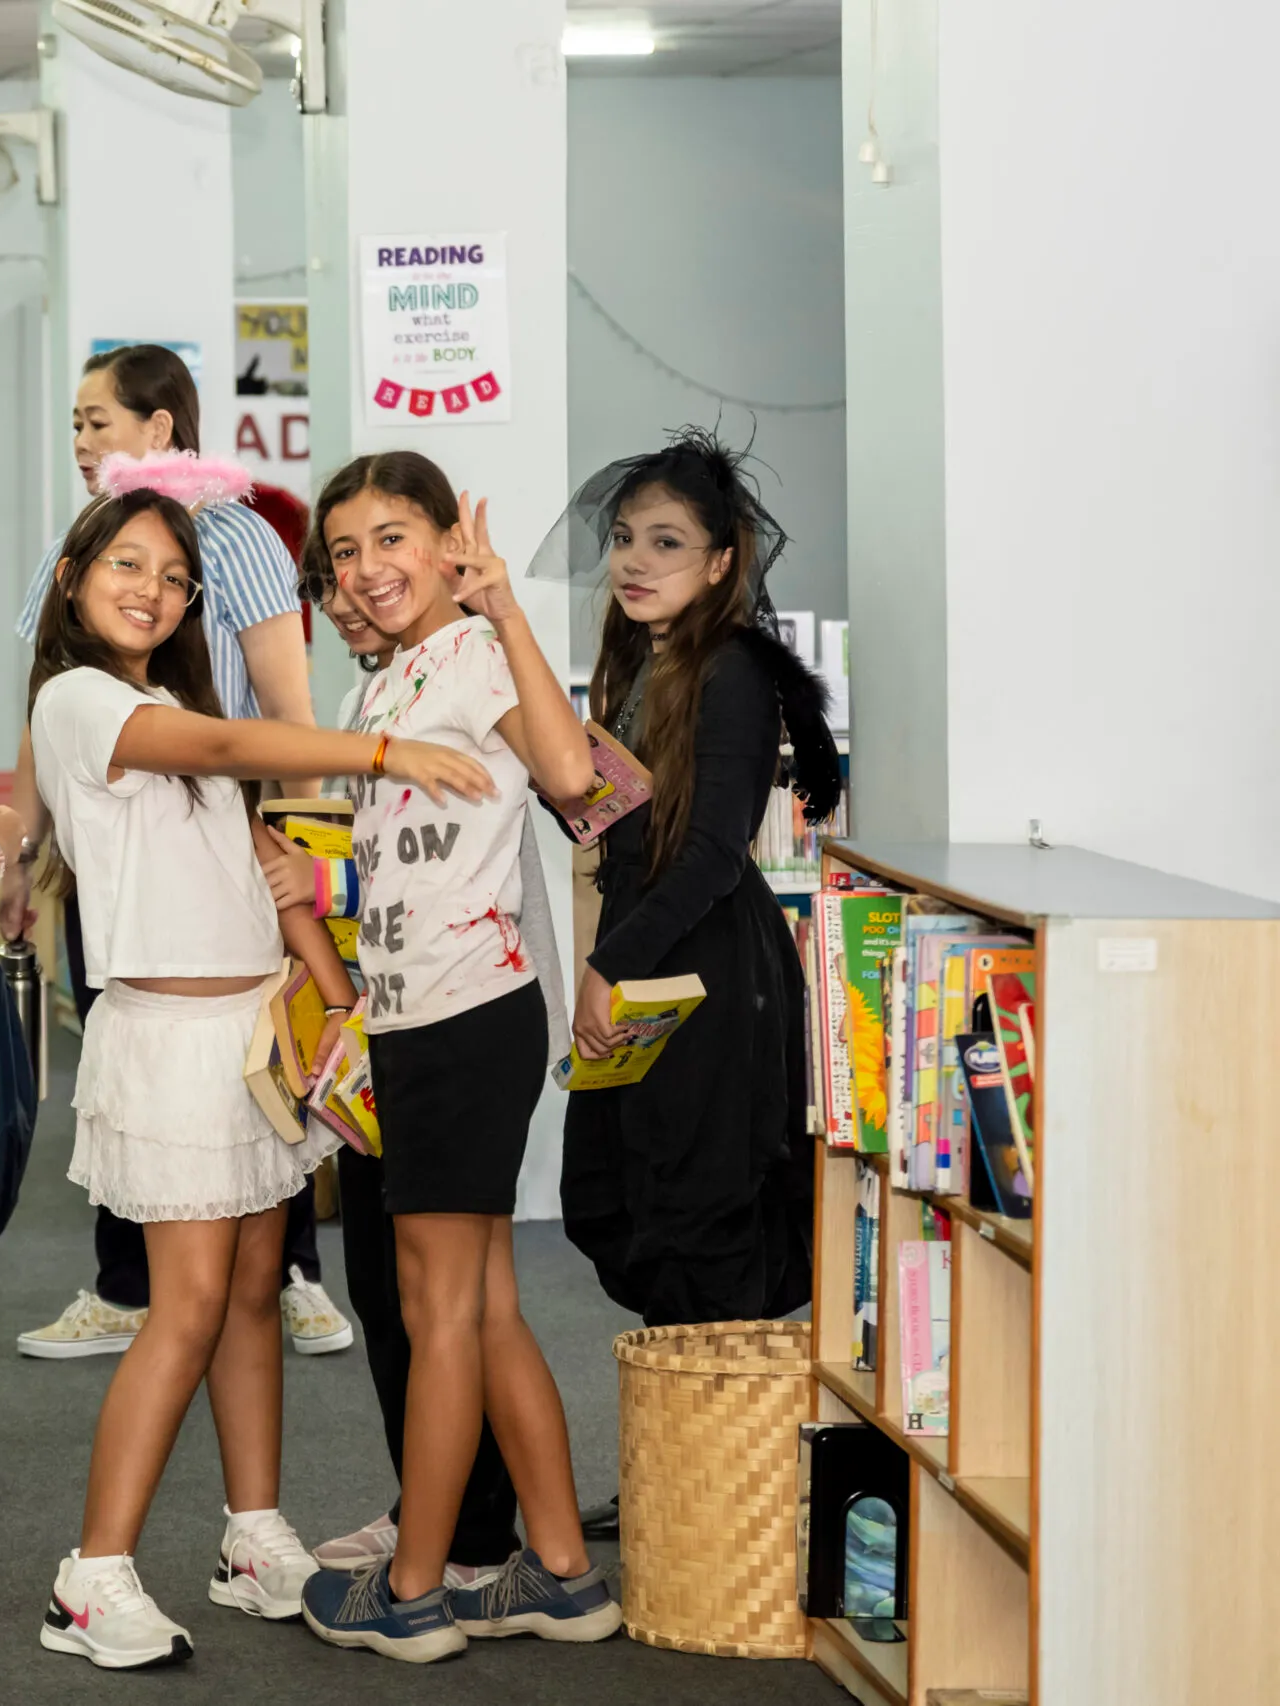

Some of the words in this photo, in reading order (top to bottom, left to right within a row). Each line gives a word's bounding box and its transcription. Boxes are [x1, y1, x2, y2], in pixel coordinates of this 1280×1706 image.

[377, 244, 484, 267] READING
[388, 283, 479, 312] MIND
[412, 313, 452, 327] what
[394, 329, 470, 344] exercise
[397, 822, 461, 865] ON
[906, 1413, 924, 1430] H
